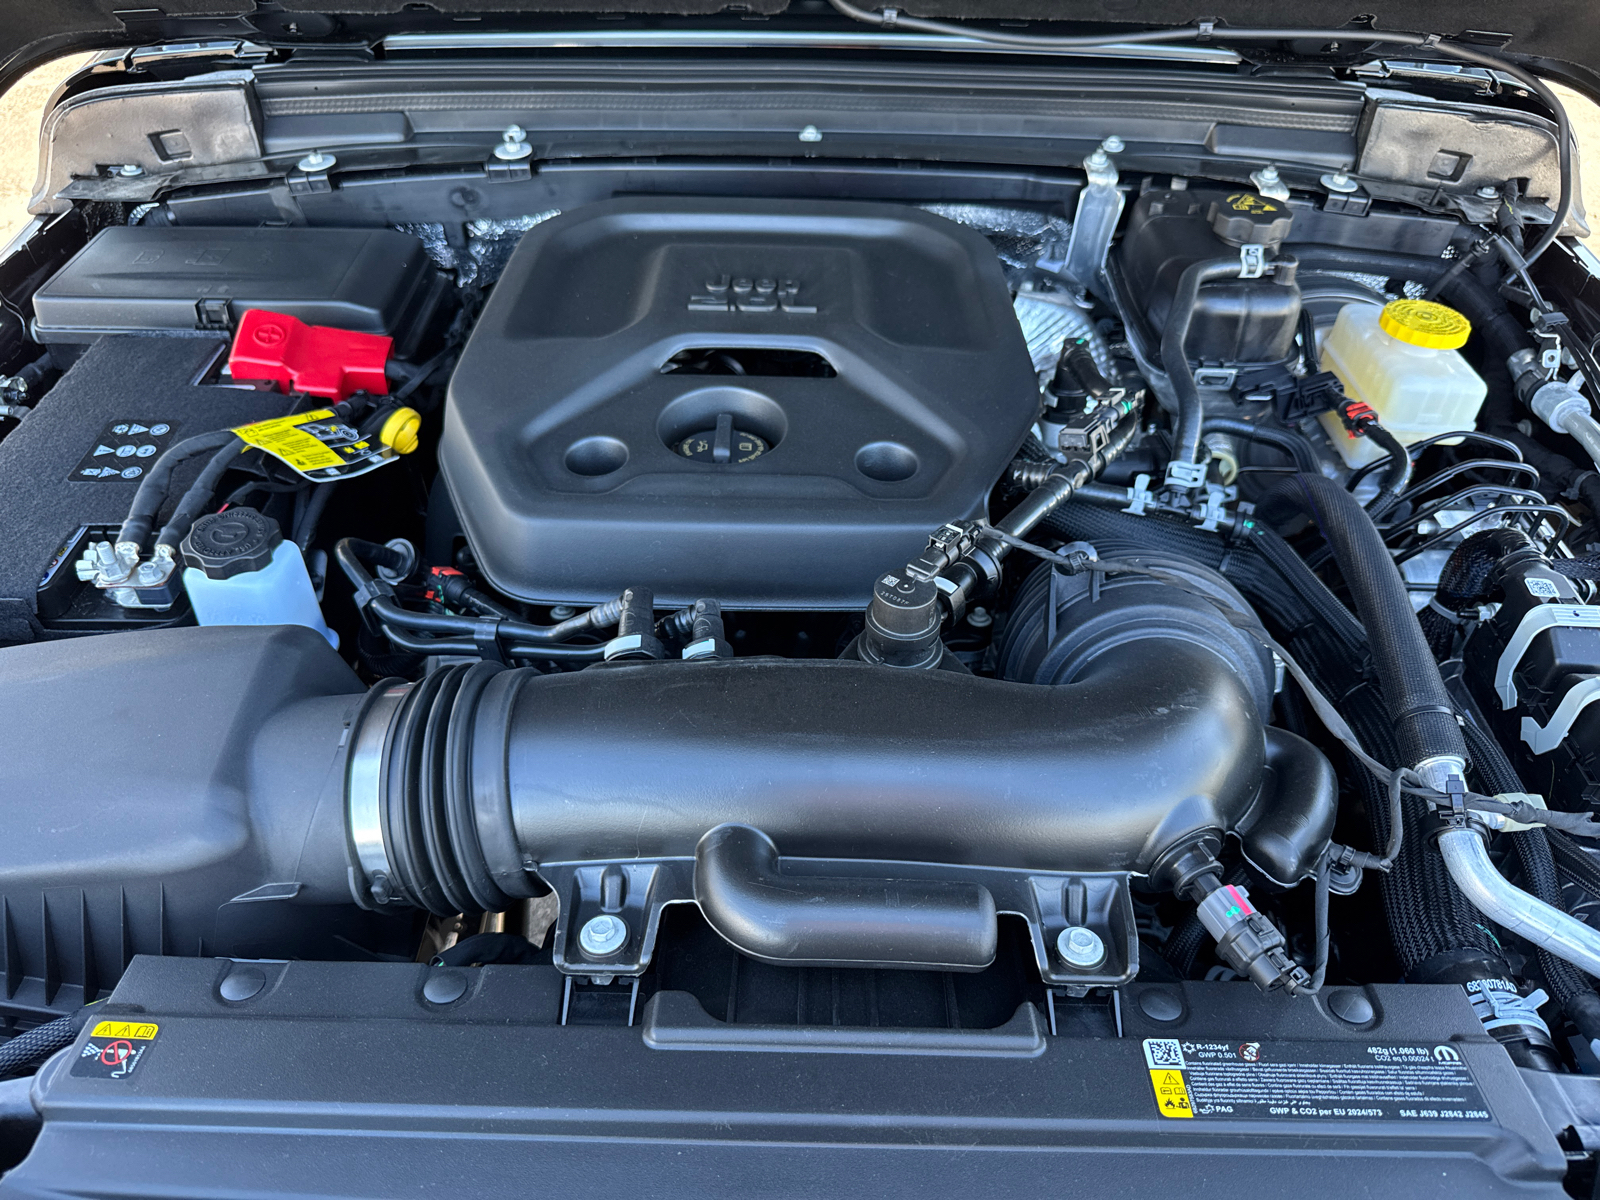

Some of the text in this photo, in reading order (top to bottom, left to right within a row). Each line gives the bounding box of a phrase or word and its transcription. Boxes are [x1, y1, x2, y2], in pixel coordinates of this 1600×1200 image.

[705, 274, 800, 297] Jeep
[1196, 1043, 1229, 1052] R-1234yf
[1367, 1046, 1389, 1056] 482g
[1416, 1047, 1430, 1057] lb)
[1402, 1055, 1431, 1063] 0.00024
[1318, 1109, 1332, 1117] per
[1347, 1109, 1383, 1117] 2024/573
[1419, 1110, 1438, 1118] J639
